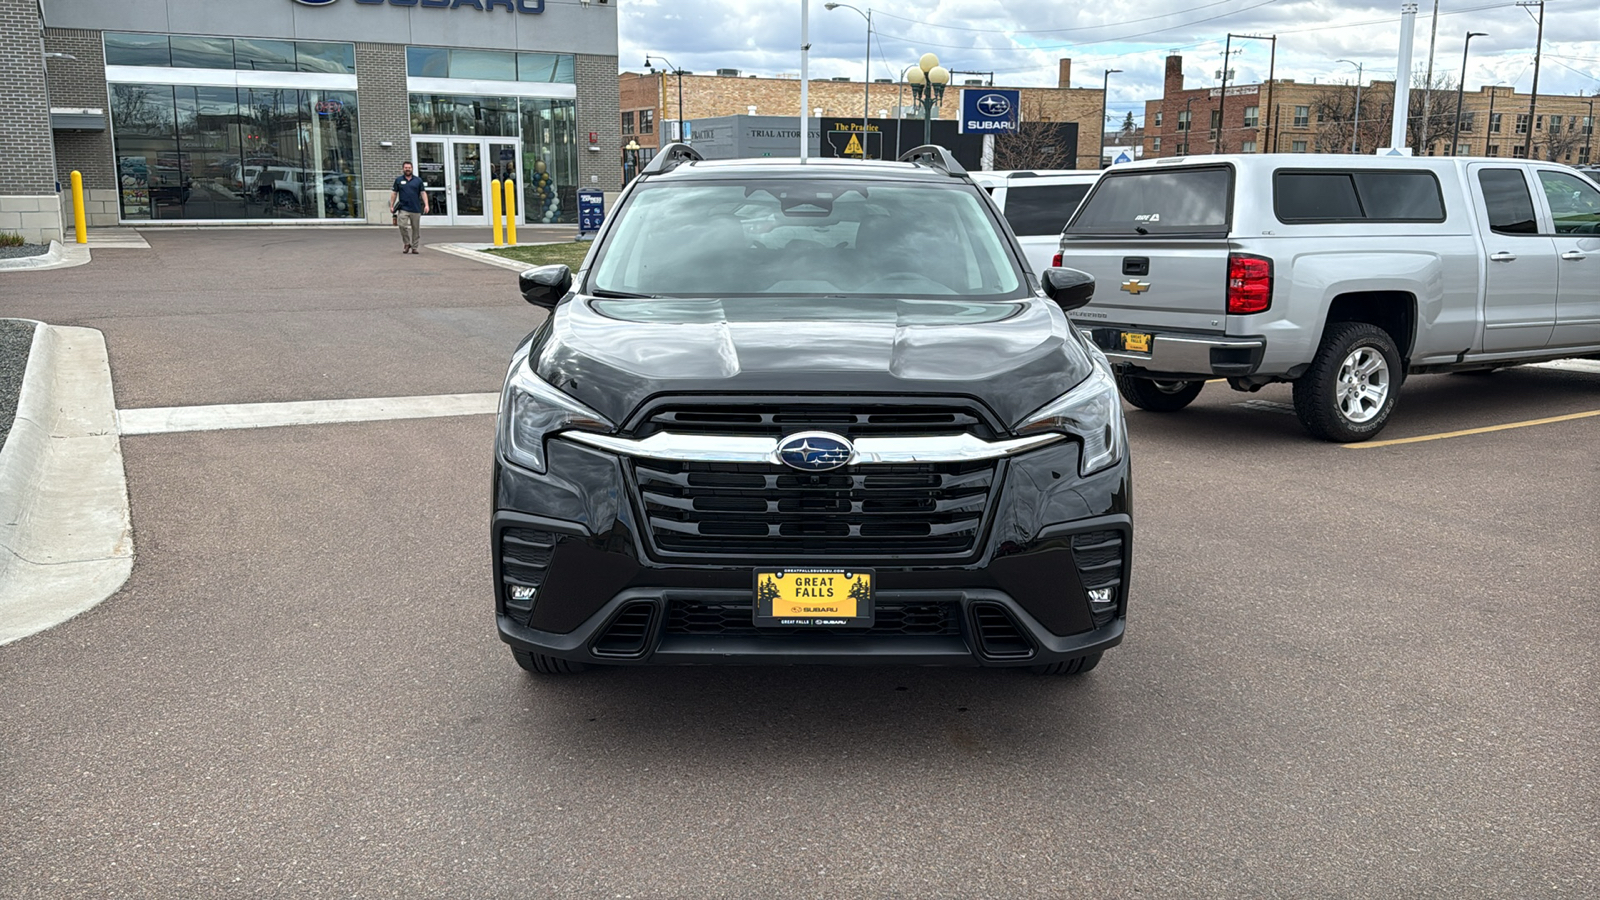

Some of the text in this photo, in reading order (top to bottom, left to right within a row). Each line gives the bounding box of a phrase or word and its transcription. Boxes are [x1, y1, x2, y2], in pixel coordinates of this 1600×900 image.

[834, 123, 879, 131] The Pratice
[968, 121, 1015, 129] SUBARU
[776, 130, 820, 138] ATTOREYS
[795, 577, 834, 586] GREAT
[795, 588, 834, 597] FALLS
